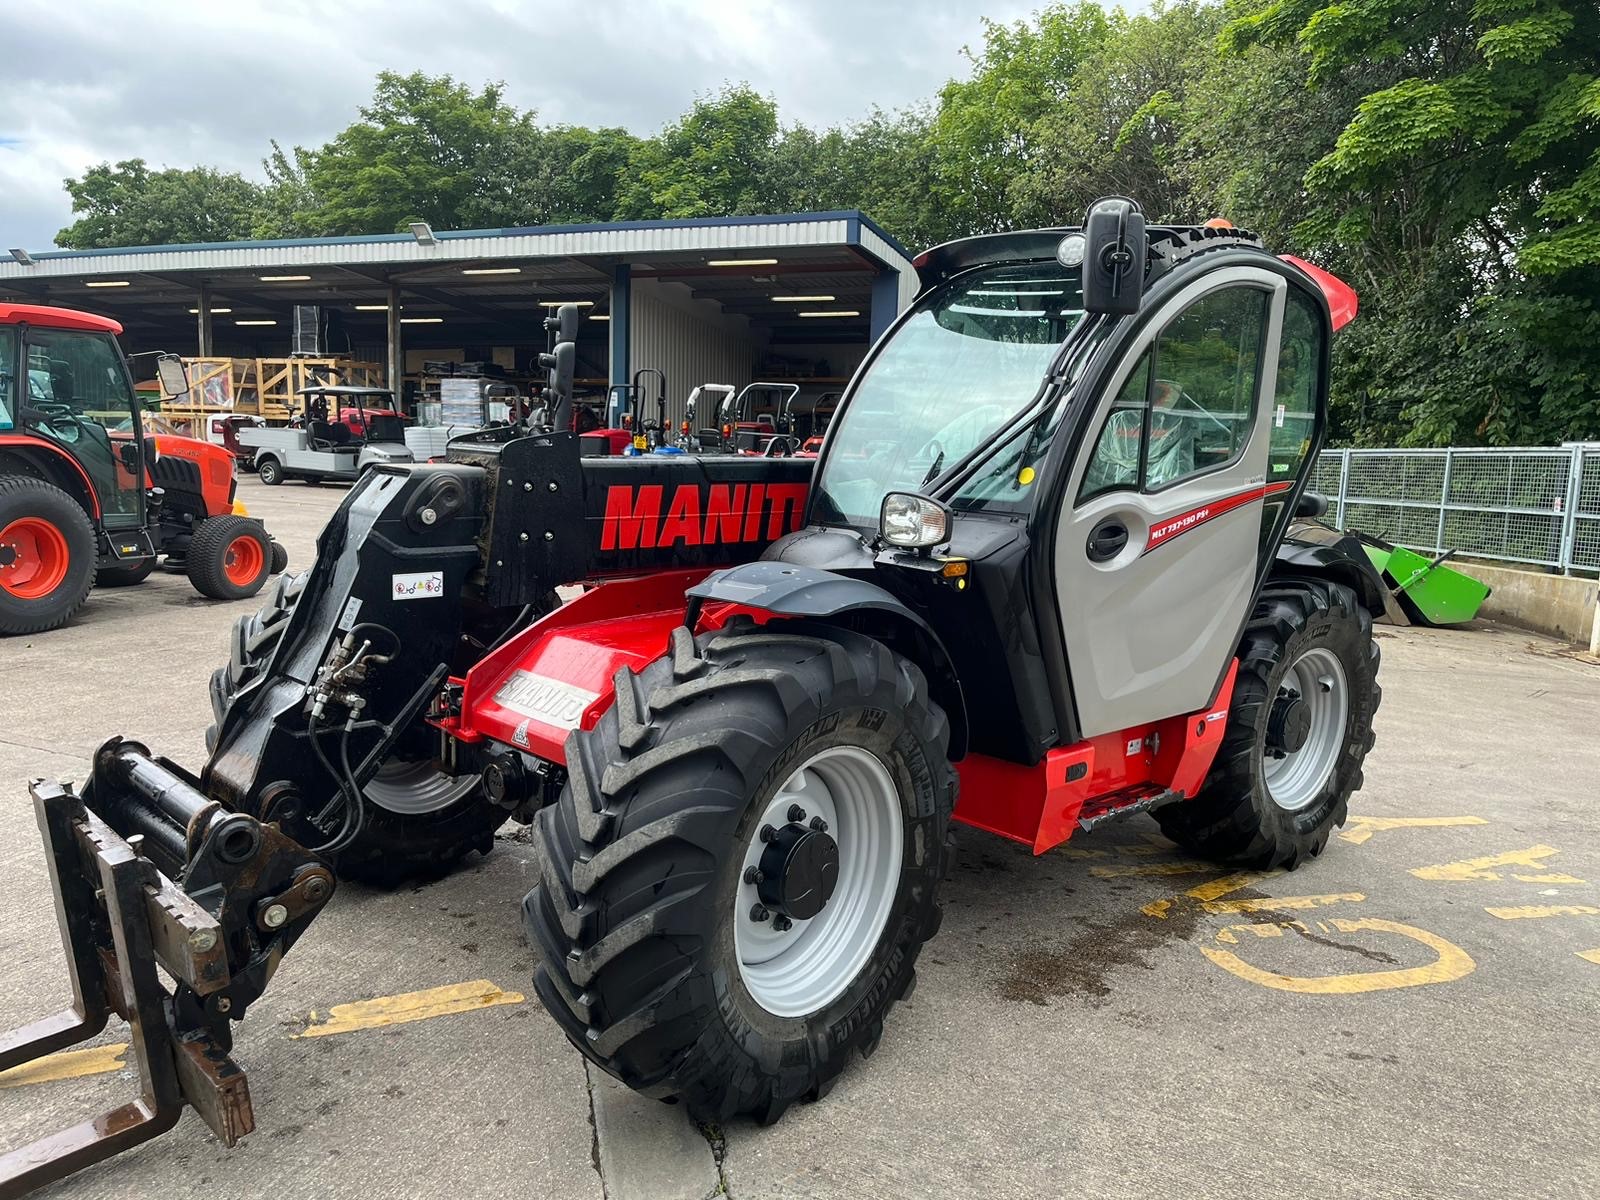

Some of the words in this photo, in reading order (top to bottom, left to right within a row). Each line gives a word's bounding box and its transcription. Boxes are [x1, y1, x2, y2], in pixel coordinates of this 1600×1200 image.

[1151, 527, 1168, 540] MLT
[1167, 515, 1196, 533] 737-130
[1196, 509, 1209, 521] PS+
[495, 675, 583, 722] MANITO
